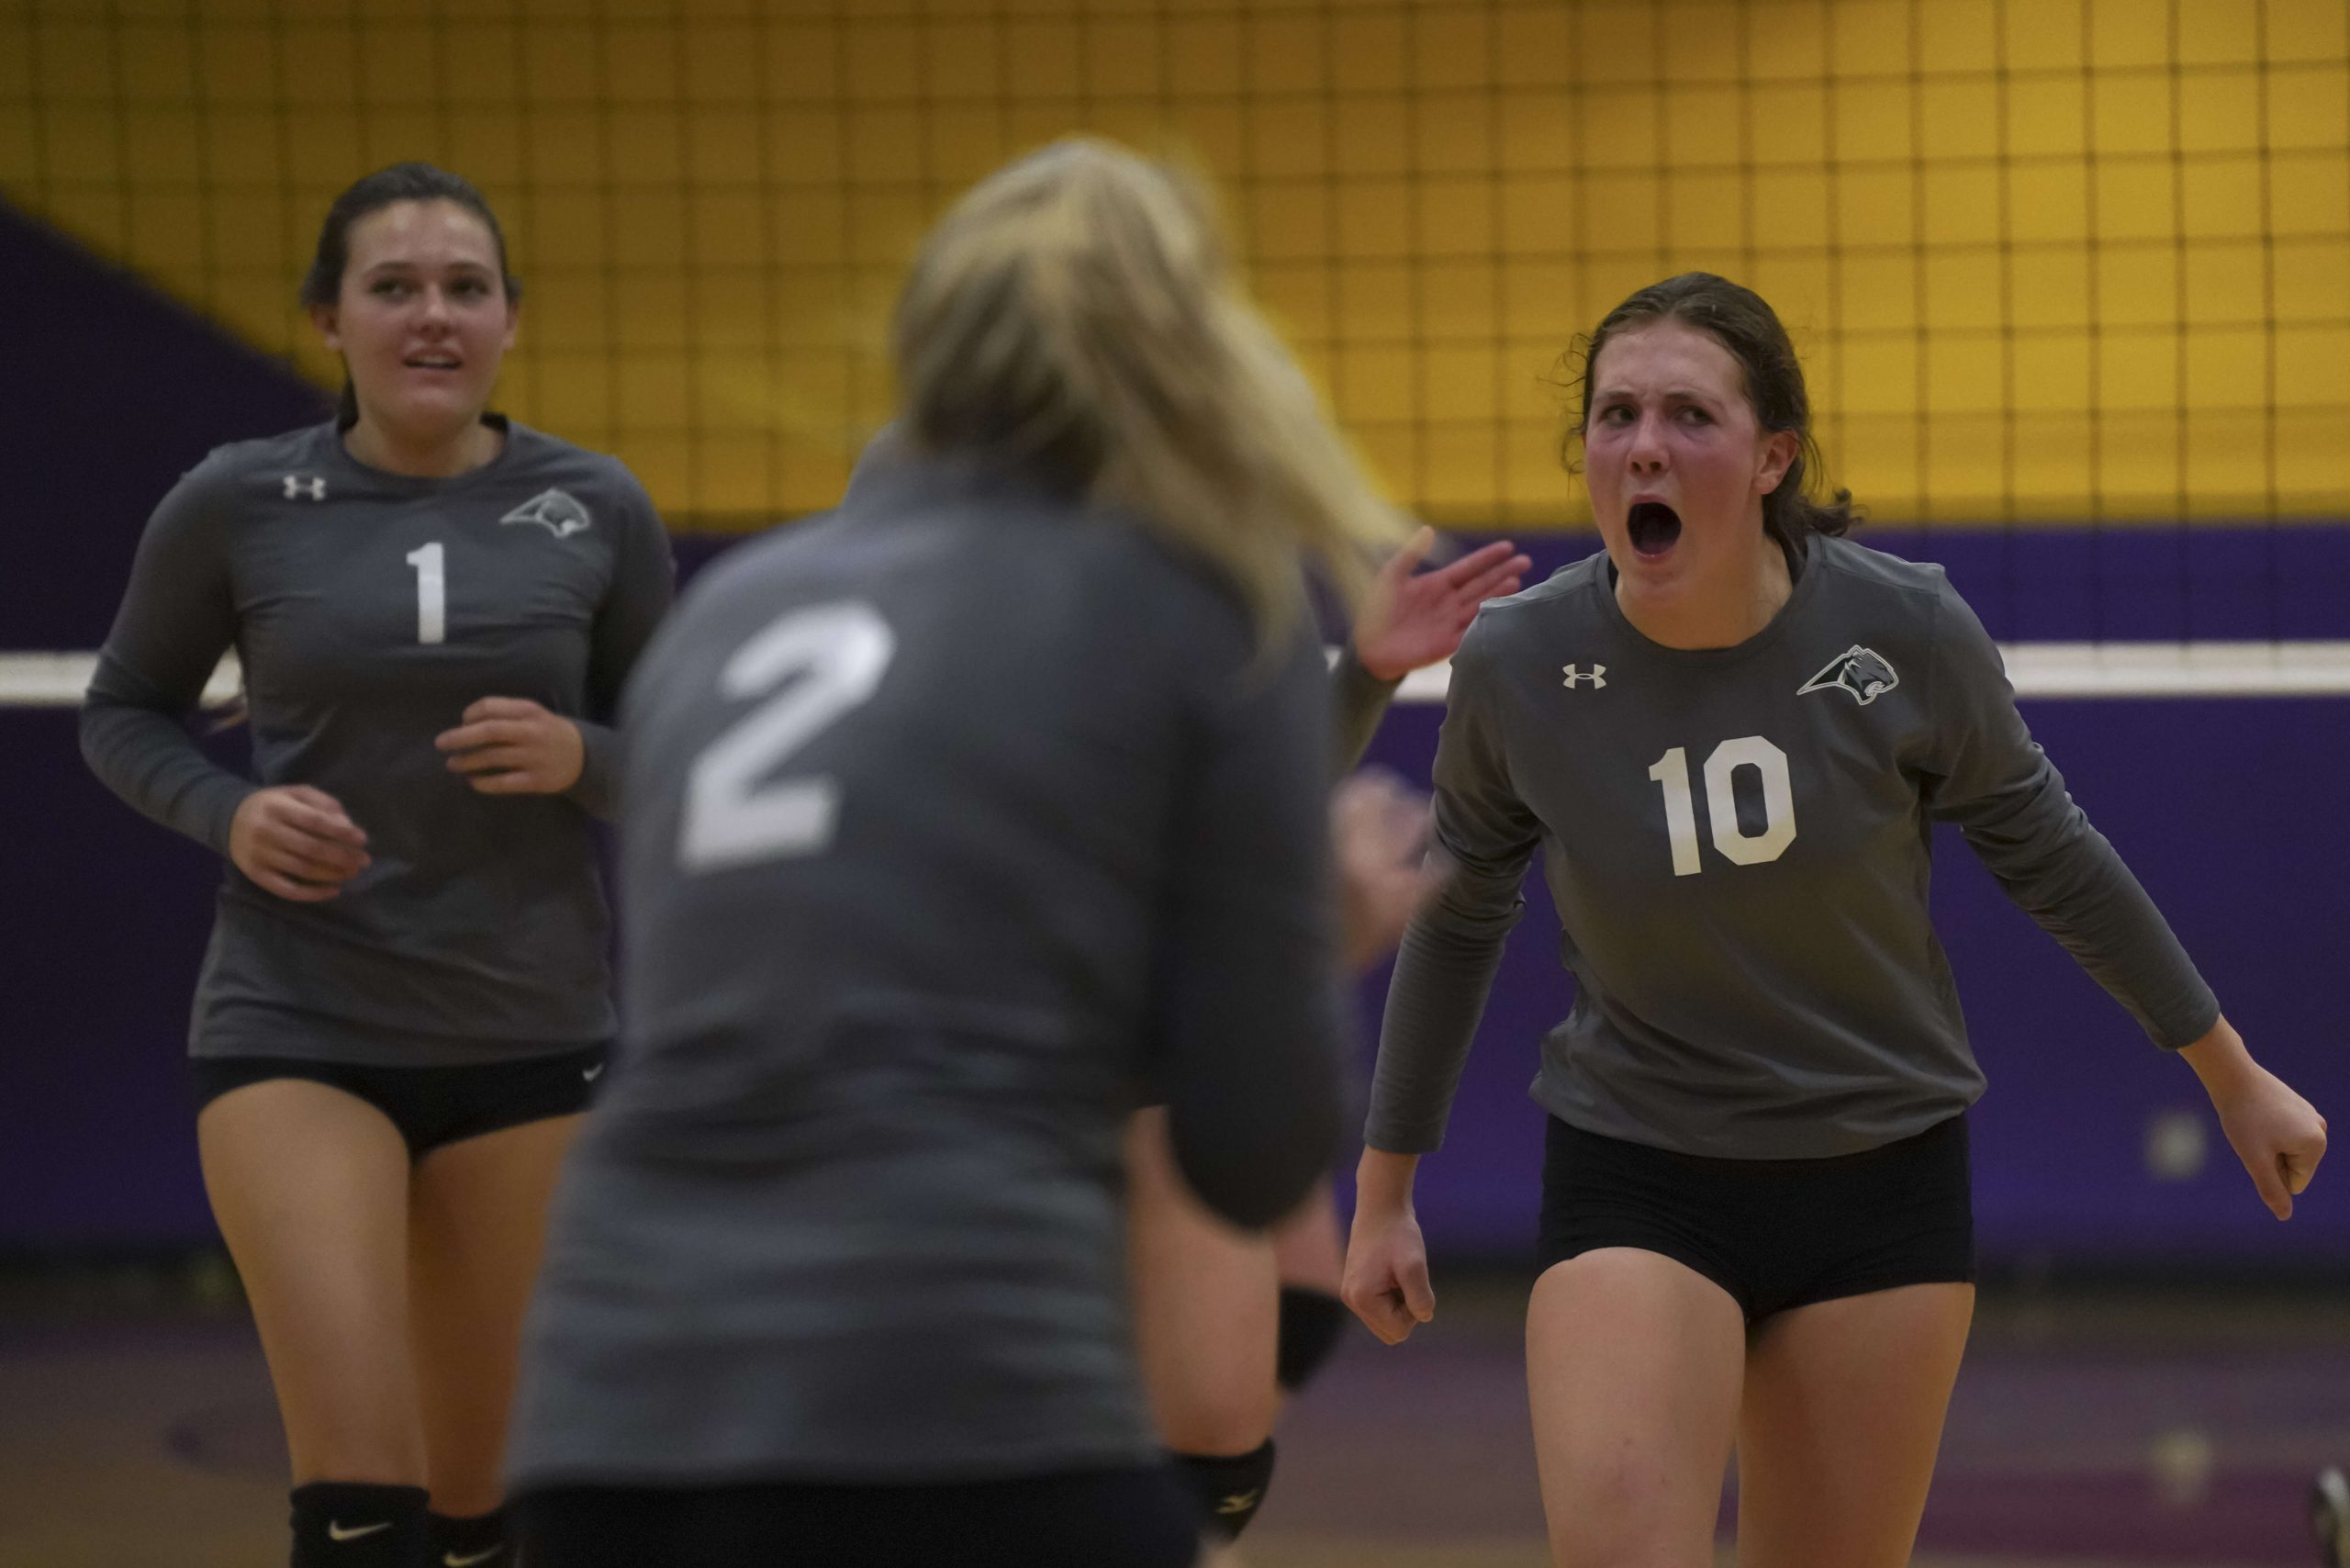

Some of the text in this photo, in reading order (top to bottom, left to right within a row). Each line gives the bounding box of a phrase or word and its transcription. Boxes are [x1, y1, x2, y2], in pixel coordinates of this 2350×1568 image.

[406, 542, 446, 644] 1
[682, 599, 897, 868] 2
[1648, 735, 1796, 877] 10
